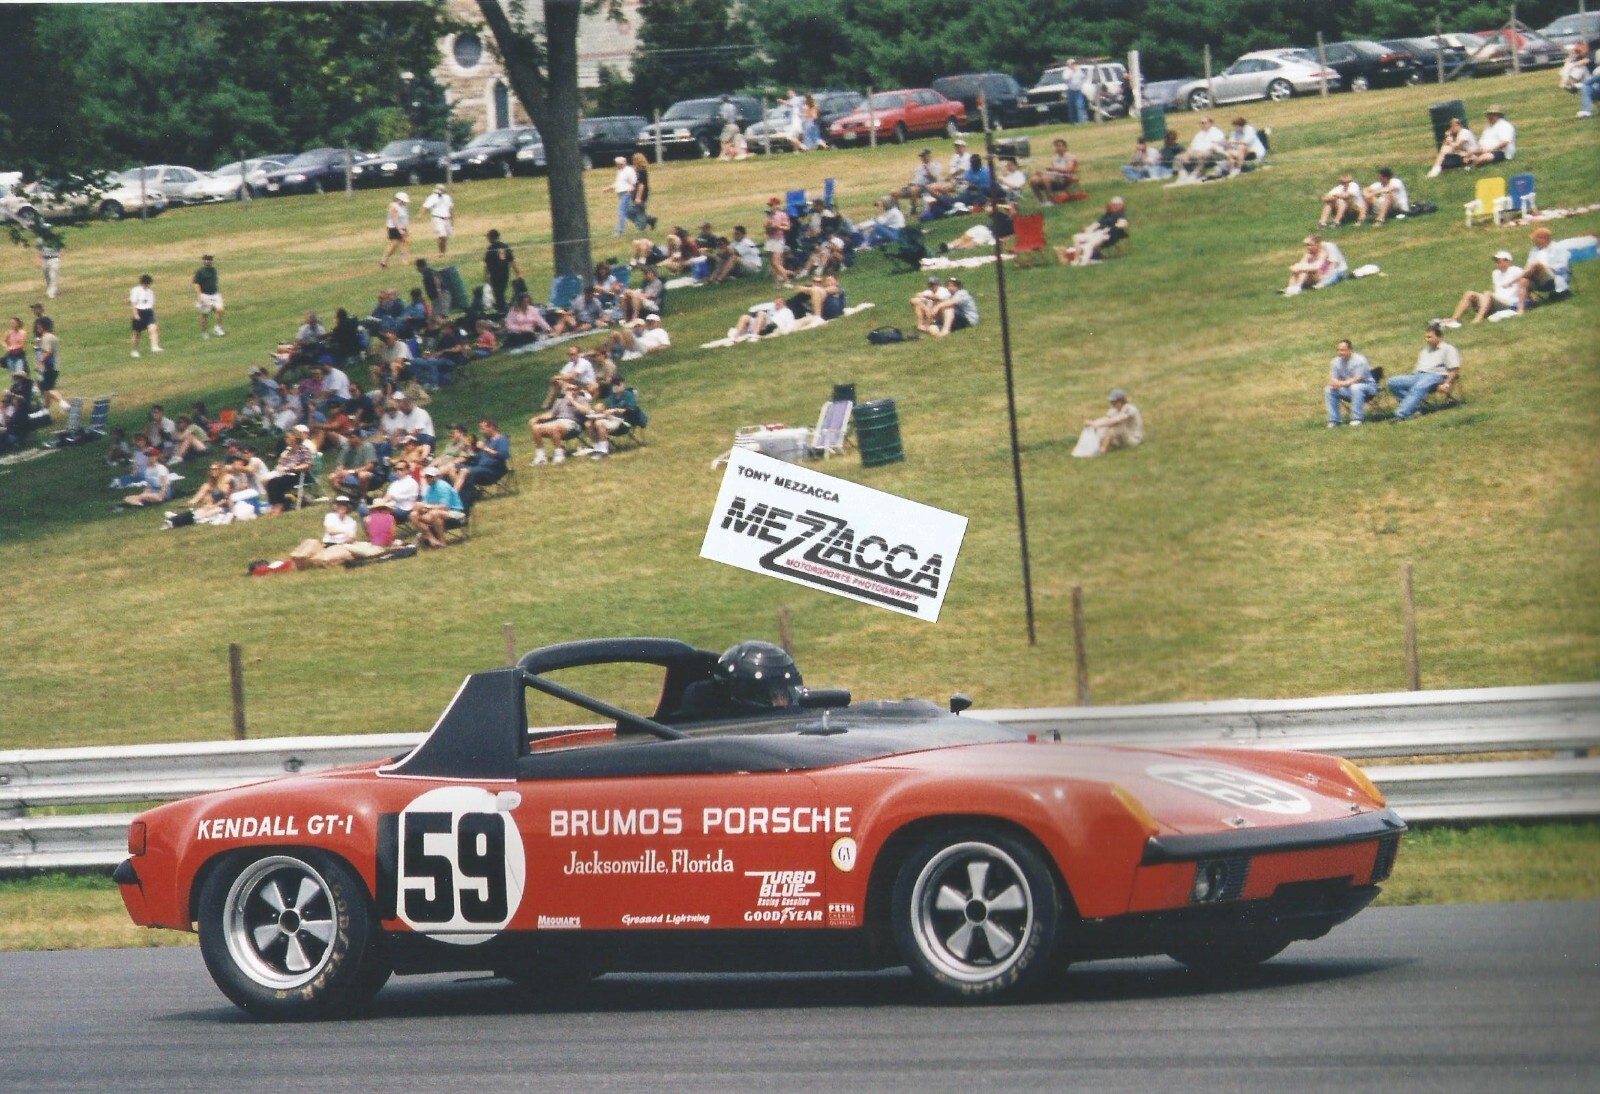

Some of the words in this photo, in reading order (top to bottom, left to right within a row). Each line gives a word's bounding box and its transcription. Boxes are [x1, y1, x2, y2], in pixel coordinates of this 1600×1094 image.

[197, 816, 299, 840] KENDALL
[550, 808, 682, 837] BRUMOS
[703, 807, 853, 834] PORSCHE
[403, 812, 508, 923] 59
[563, 849, 669, 875] Jacksonville,
[671, 849, 735, 874] Florida
[744, 870, 816, 885] TURBO
[759, 883, 821, 897] BLUE
[621, 914, 663, 925] Greased
[665, 914, 710, 925] Lightning
[743, 906, 823, 924] GOODYEAR
